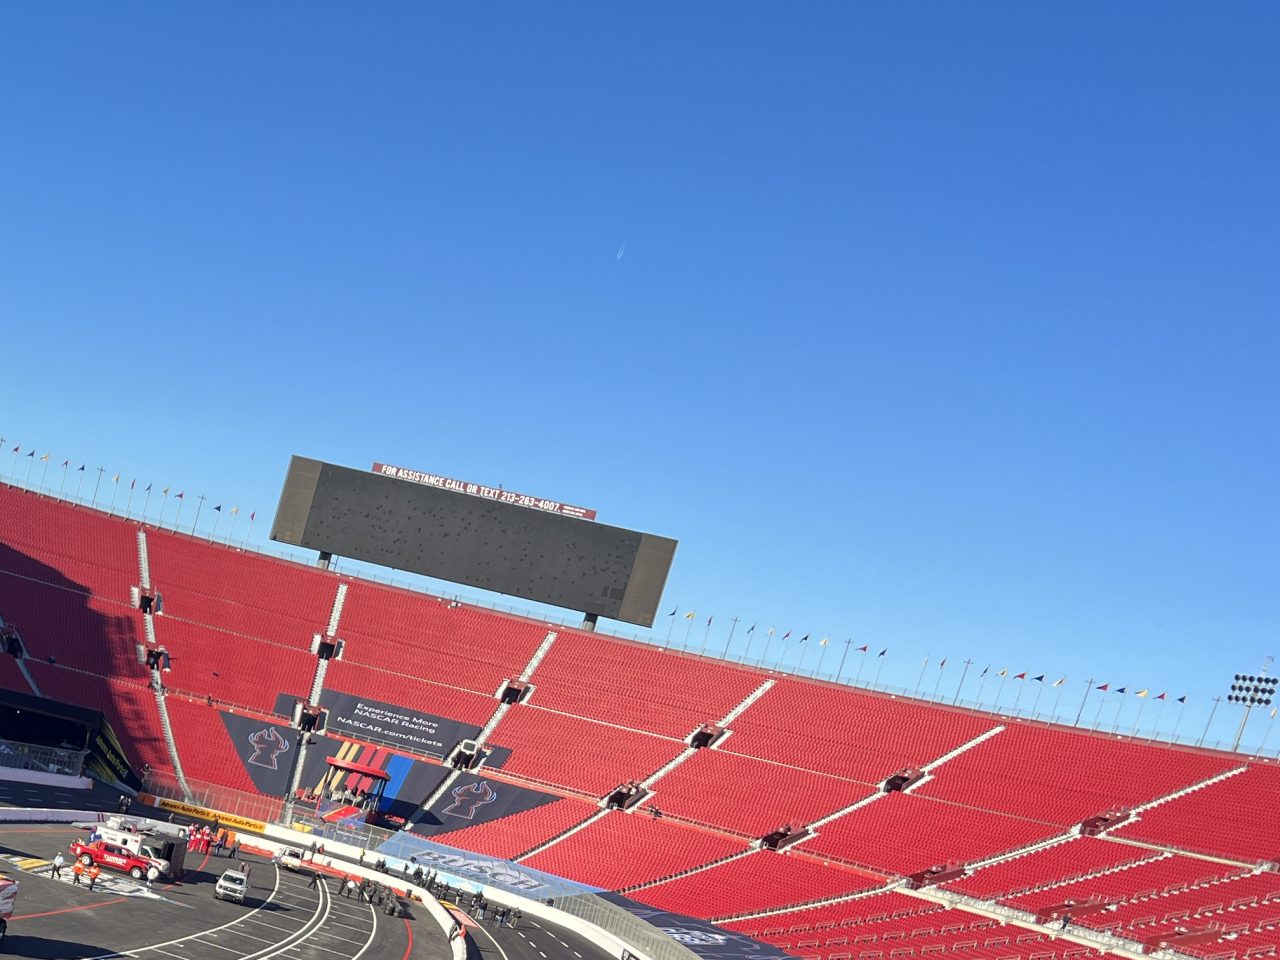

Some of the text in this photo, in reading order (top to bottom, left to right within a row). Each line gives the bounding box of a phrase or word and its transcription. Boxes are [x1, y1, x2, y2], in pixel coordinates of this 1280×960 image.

[381, 465, 397, 476] FOR
[397, 468, 445, 488] ASSISTANCE
[445, 479, 465, 492] CALL
[466, 483, 478, 495] OR
[479, 486, 500, 500] TEXT
[354, 708, 436, 734] NASCAR Racing
[356, 702, 439, 728] Experience More
[337, 716, 443, 747] NASCAR.com/tickets
